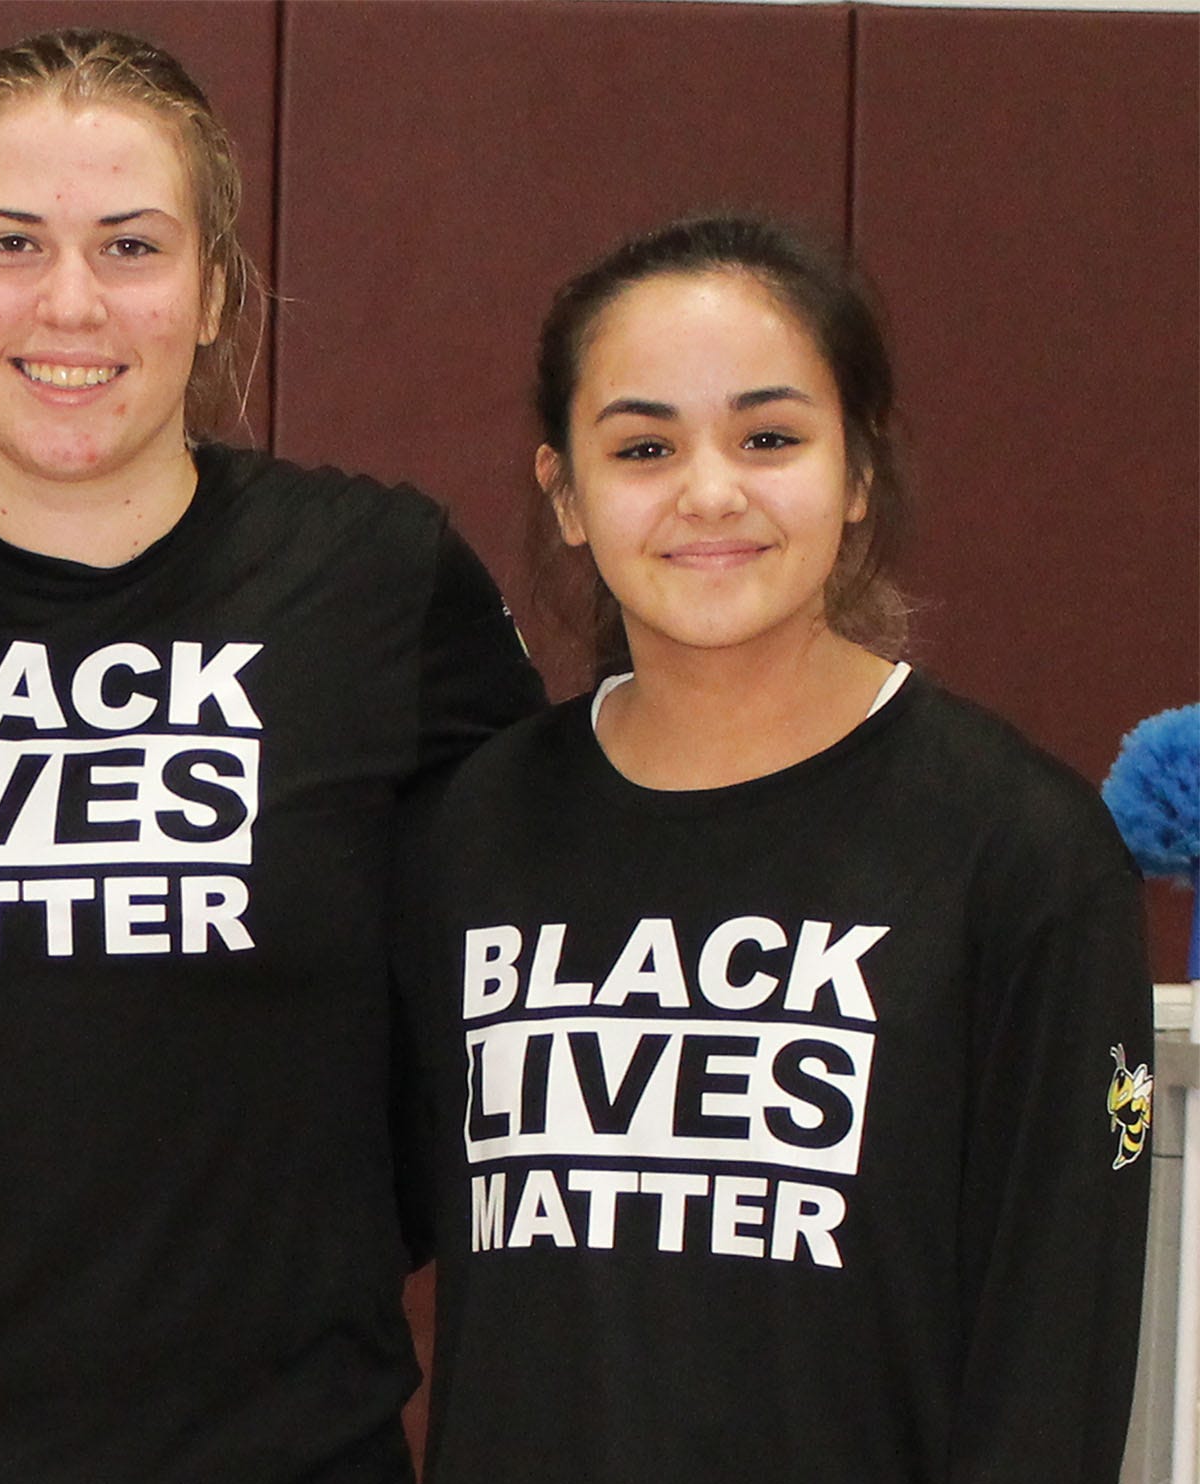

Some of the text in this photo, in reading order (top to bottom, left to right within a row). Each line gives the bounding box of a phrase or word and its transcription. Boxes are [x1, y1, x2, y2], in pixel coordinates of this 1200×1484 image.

[463, 915, 890, 1021] BLACK
[468, 1031, 855, 1150] LIVES
[470, 1169, 846, 1268] MATTER
